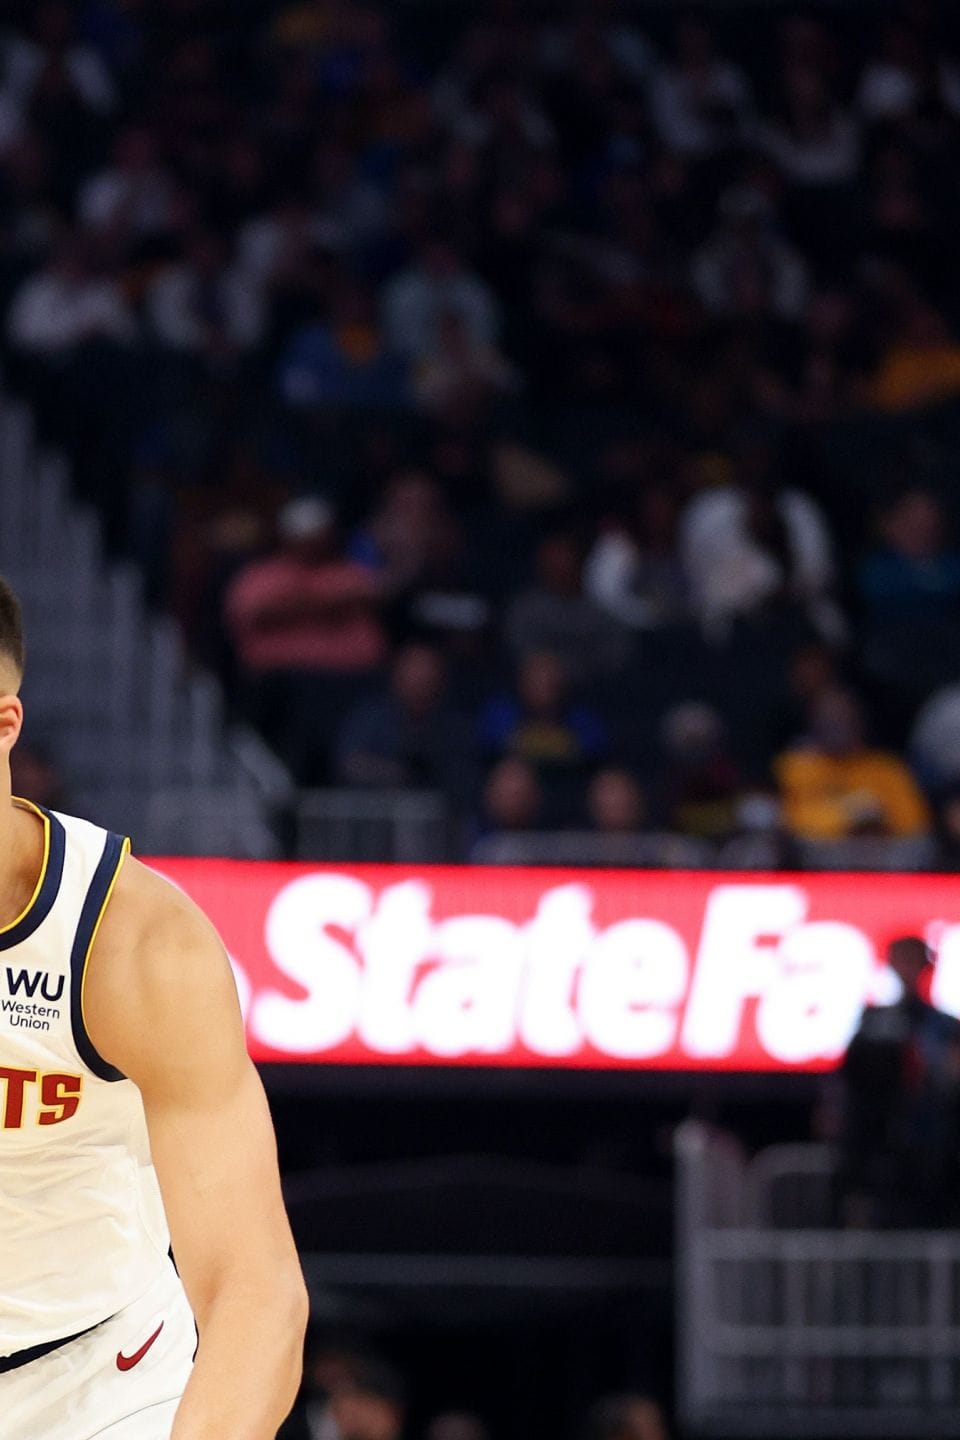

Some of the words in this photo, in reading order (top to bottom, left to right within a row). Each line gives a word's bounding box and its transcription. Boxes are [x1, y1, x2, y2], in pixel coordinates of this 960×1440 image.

[5, 966, 66, 1002] WU
[1, 999, 61, 1020] Western
[9, 1013, 51, 1031] Union
